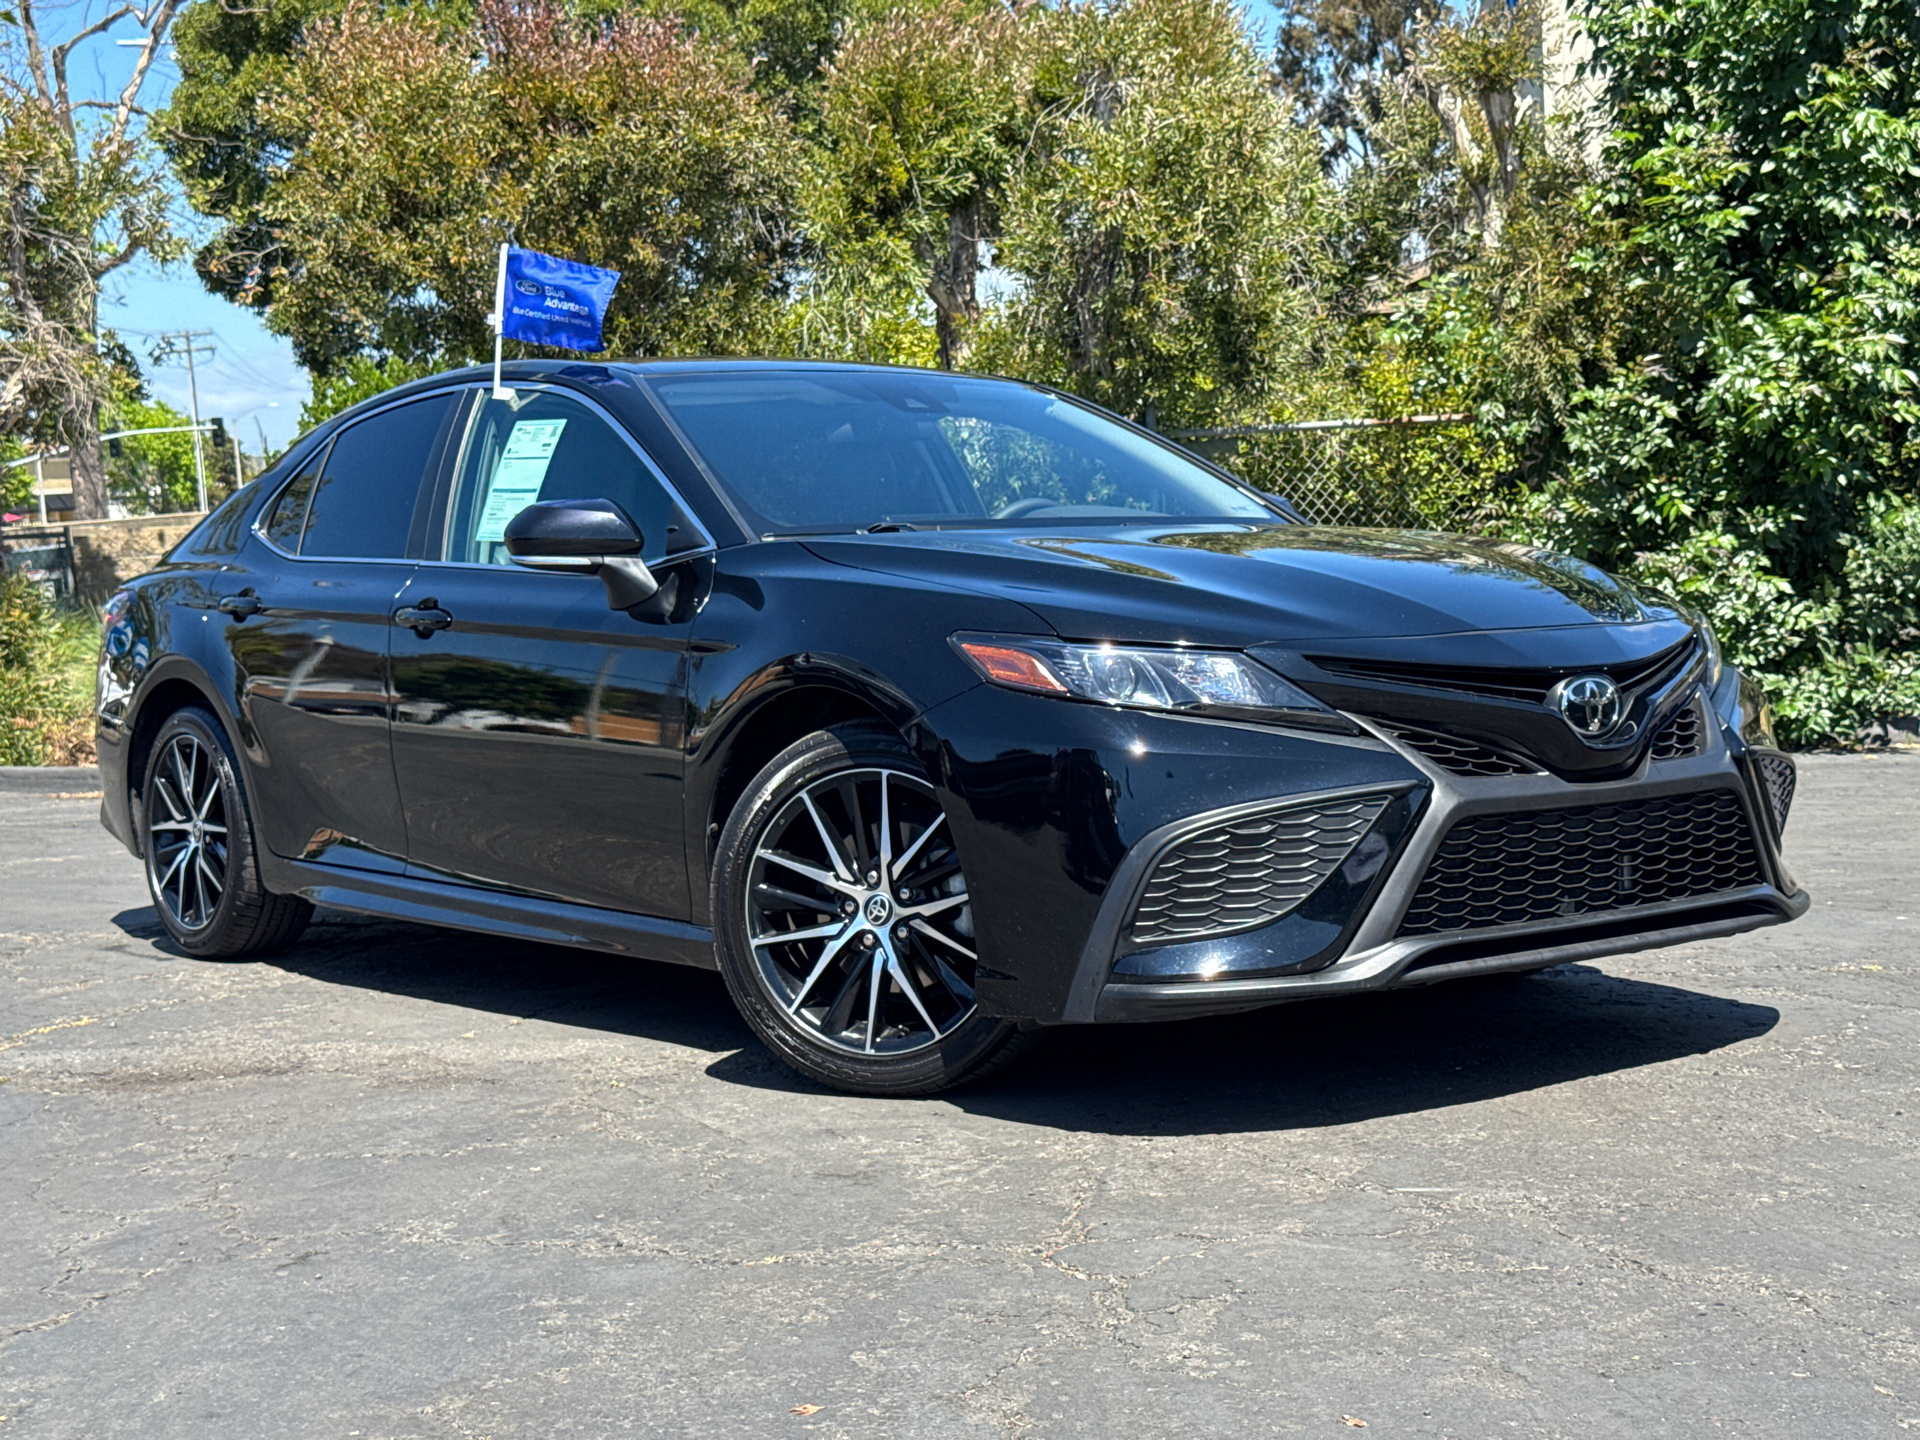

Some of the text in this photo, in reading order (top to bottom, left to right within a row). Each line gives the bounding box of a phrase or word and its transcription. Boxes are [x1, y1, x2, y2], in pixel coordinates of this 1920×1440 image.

[544, 286, 565, 298] Blue
[513, 306, 524, 314] Blue
[525, 308, 550, 320] Certified
[551, 315, 569, 323] Used
